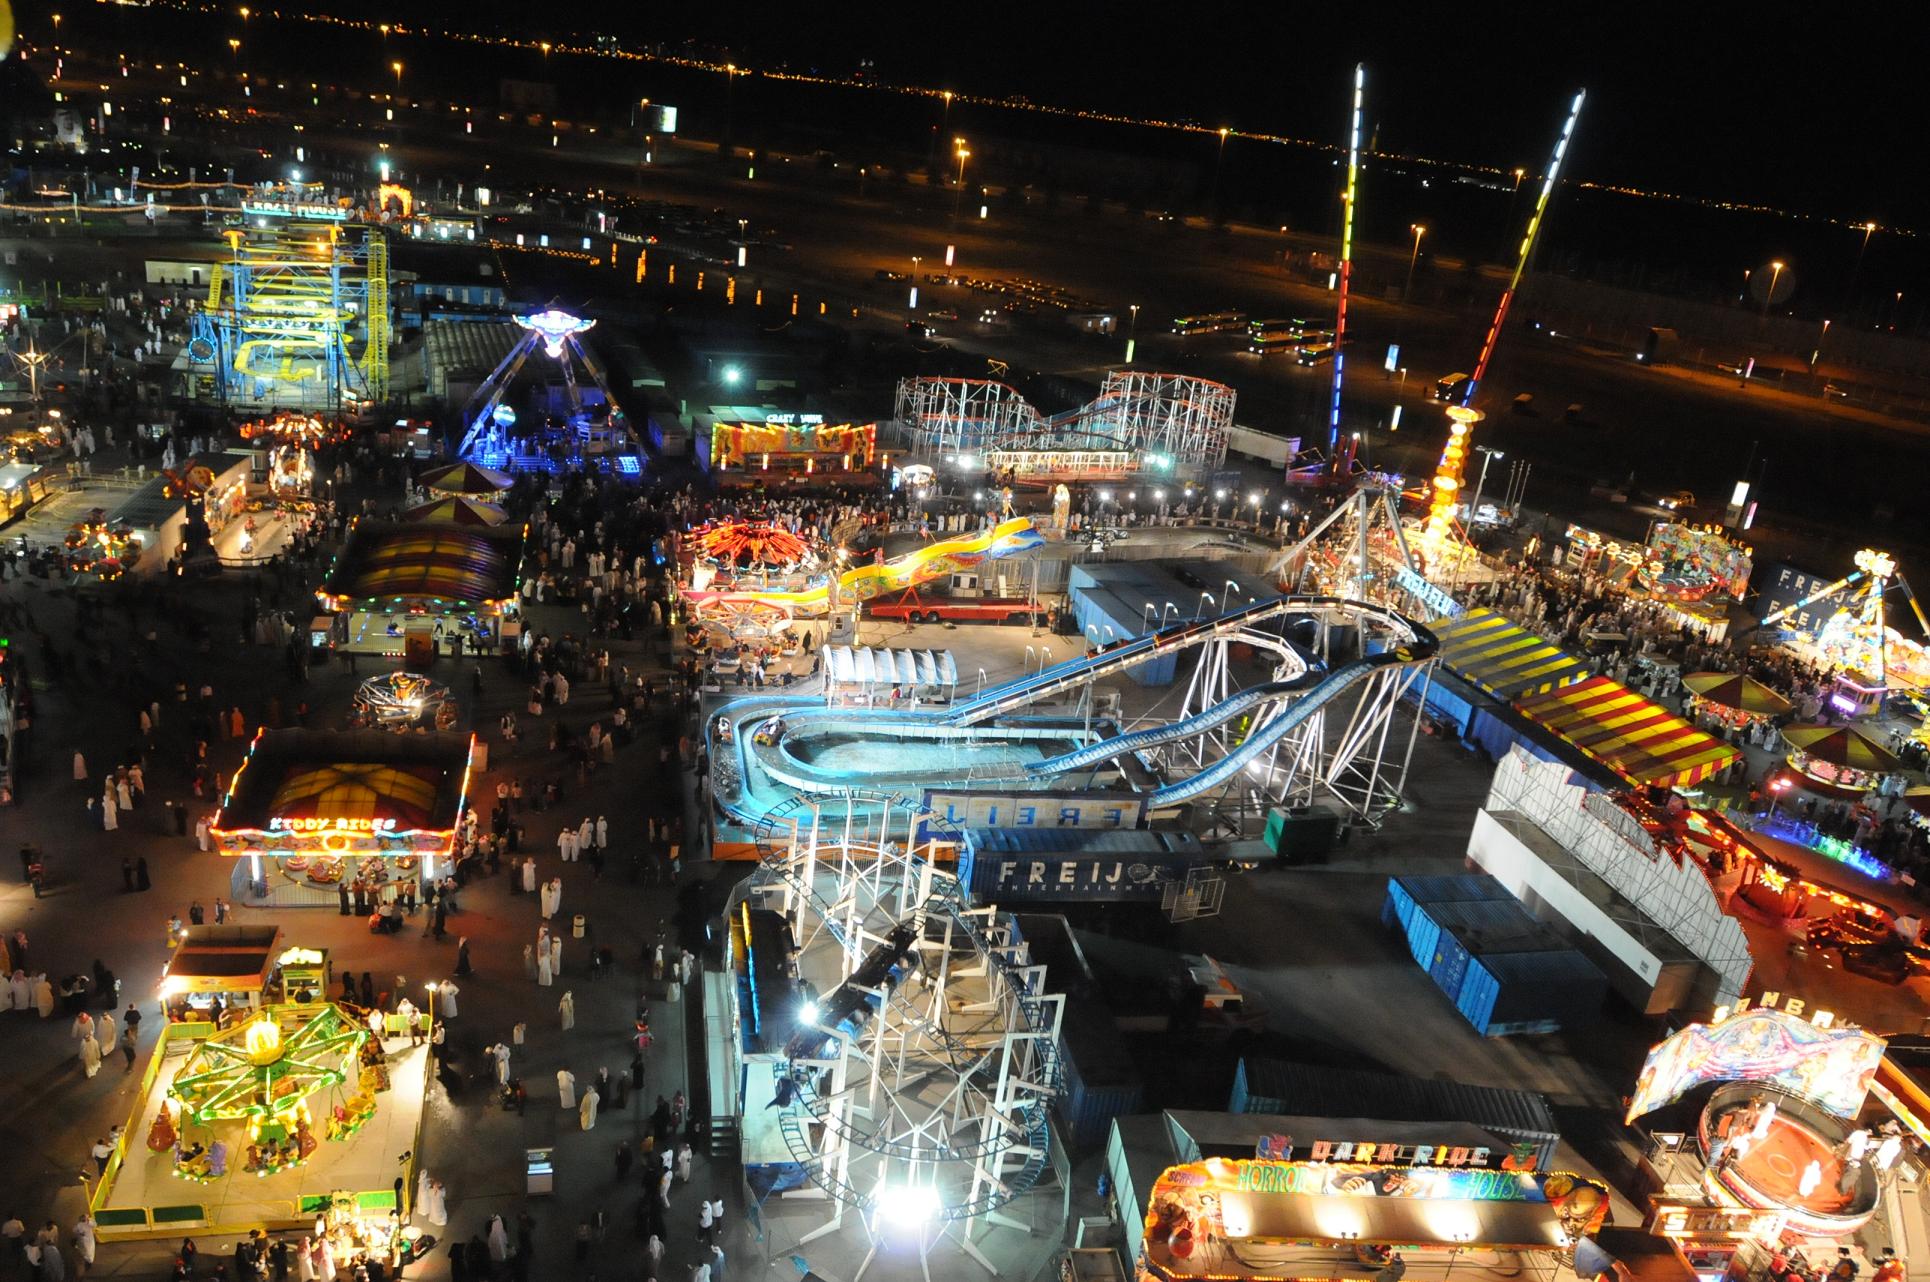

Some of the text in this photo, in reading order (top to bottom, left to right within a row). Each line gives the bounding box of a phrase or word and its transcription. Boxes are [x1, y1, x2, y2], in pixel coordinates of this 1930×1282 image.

[269, 817, 397, 831] KIDDY RIDES
[998, 861, 1123, 883] FREIJ
[1711, 991, 1835, 1029] SAMBA
[1311, 1140, 1491, 1166] DARK RIDE
